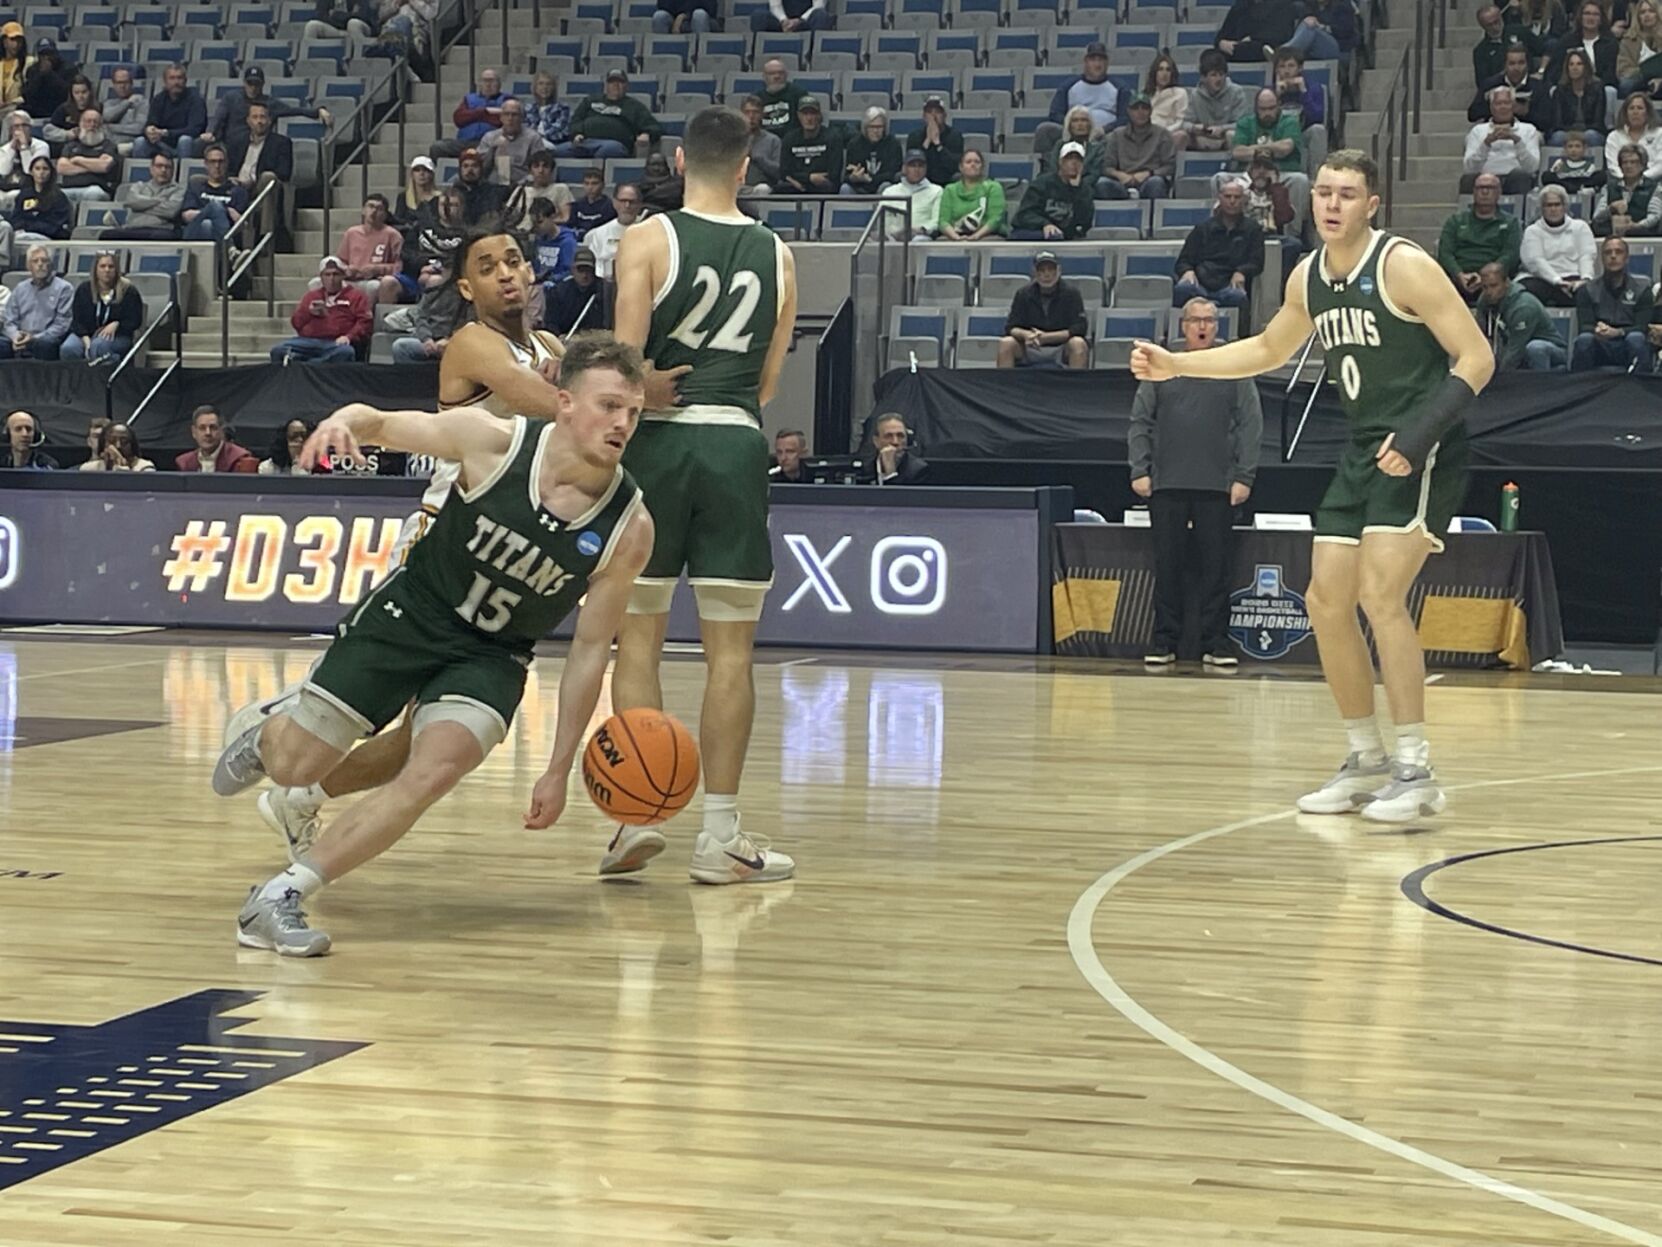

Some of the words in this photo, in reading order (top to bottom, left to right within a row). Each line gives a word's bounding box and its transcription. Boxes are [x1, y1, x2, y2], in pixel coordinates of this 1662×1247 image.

[667, 265, 761, 353] 22
[1313, 307, 1381, 350] TITANS
[1341, 354, 1361, 401] 0
[162, 515, 403, 604] #D3H
[466, 514, 576, 597] TITANS
[781, 534, 852, 613] X
[454, 571, 522, 633] 15
